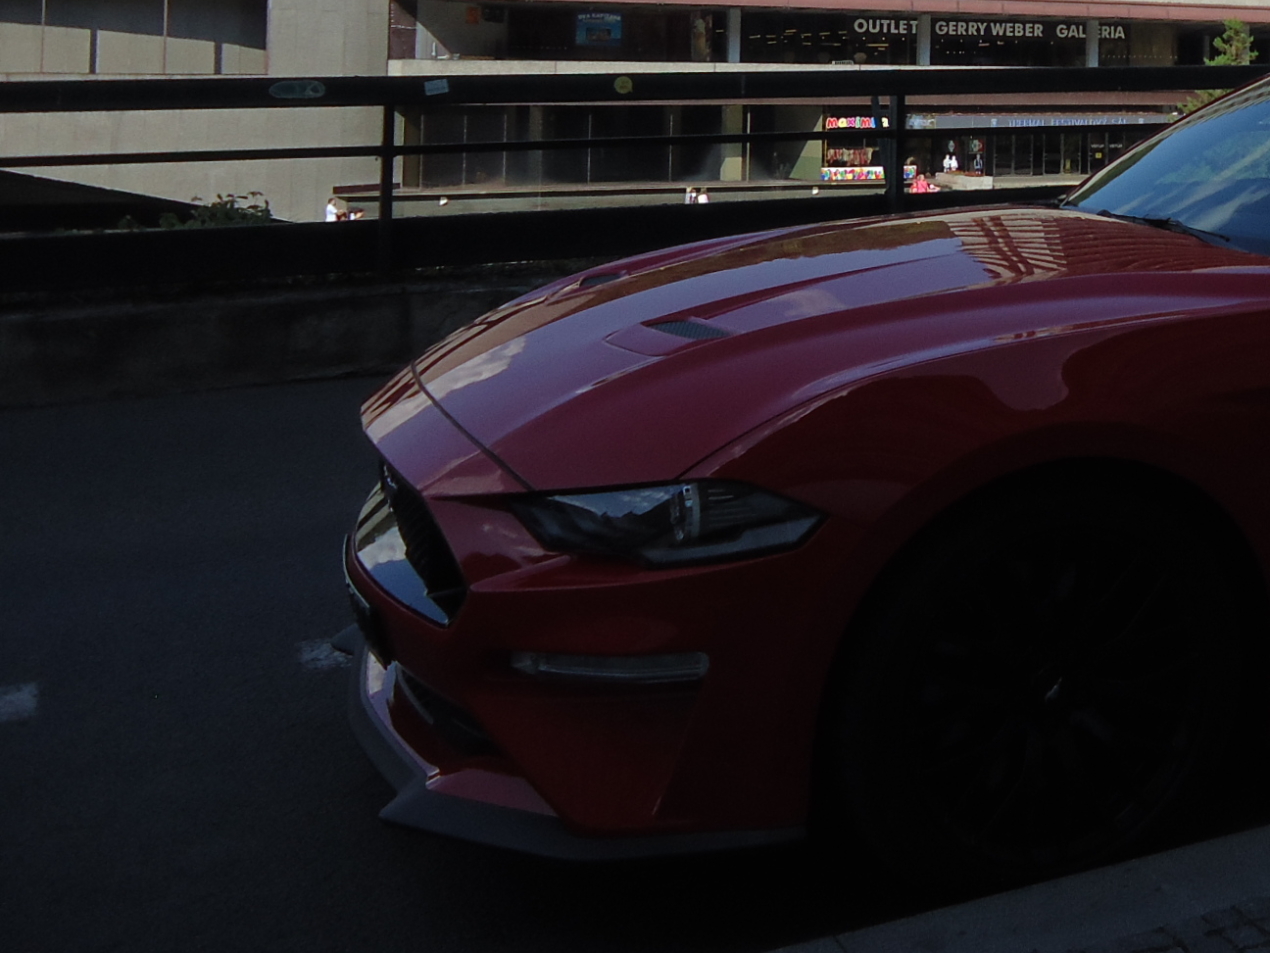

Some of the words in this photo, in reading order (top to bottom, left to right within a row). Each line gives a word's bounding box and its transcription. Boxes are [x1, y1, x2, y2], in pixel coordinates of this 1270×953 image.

[853, 18, 918, 33] OUTLET
[935, 20, 988, 35] GERRY
[990, 22, 1044, 37] WEBER
